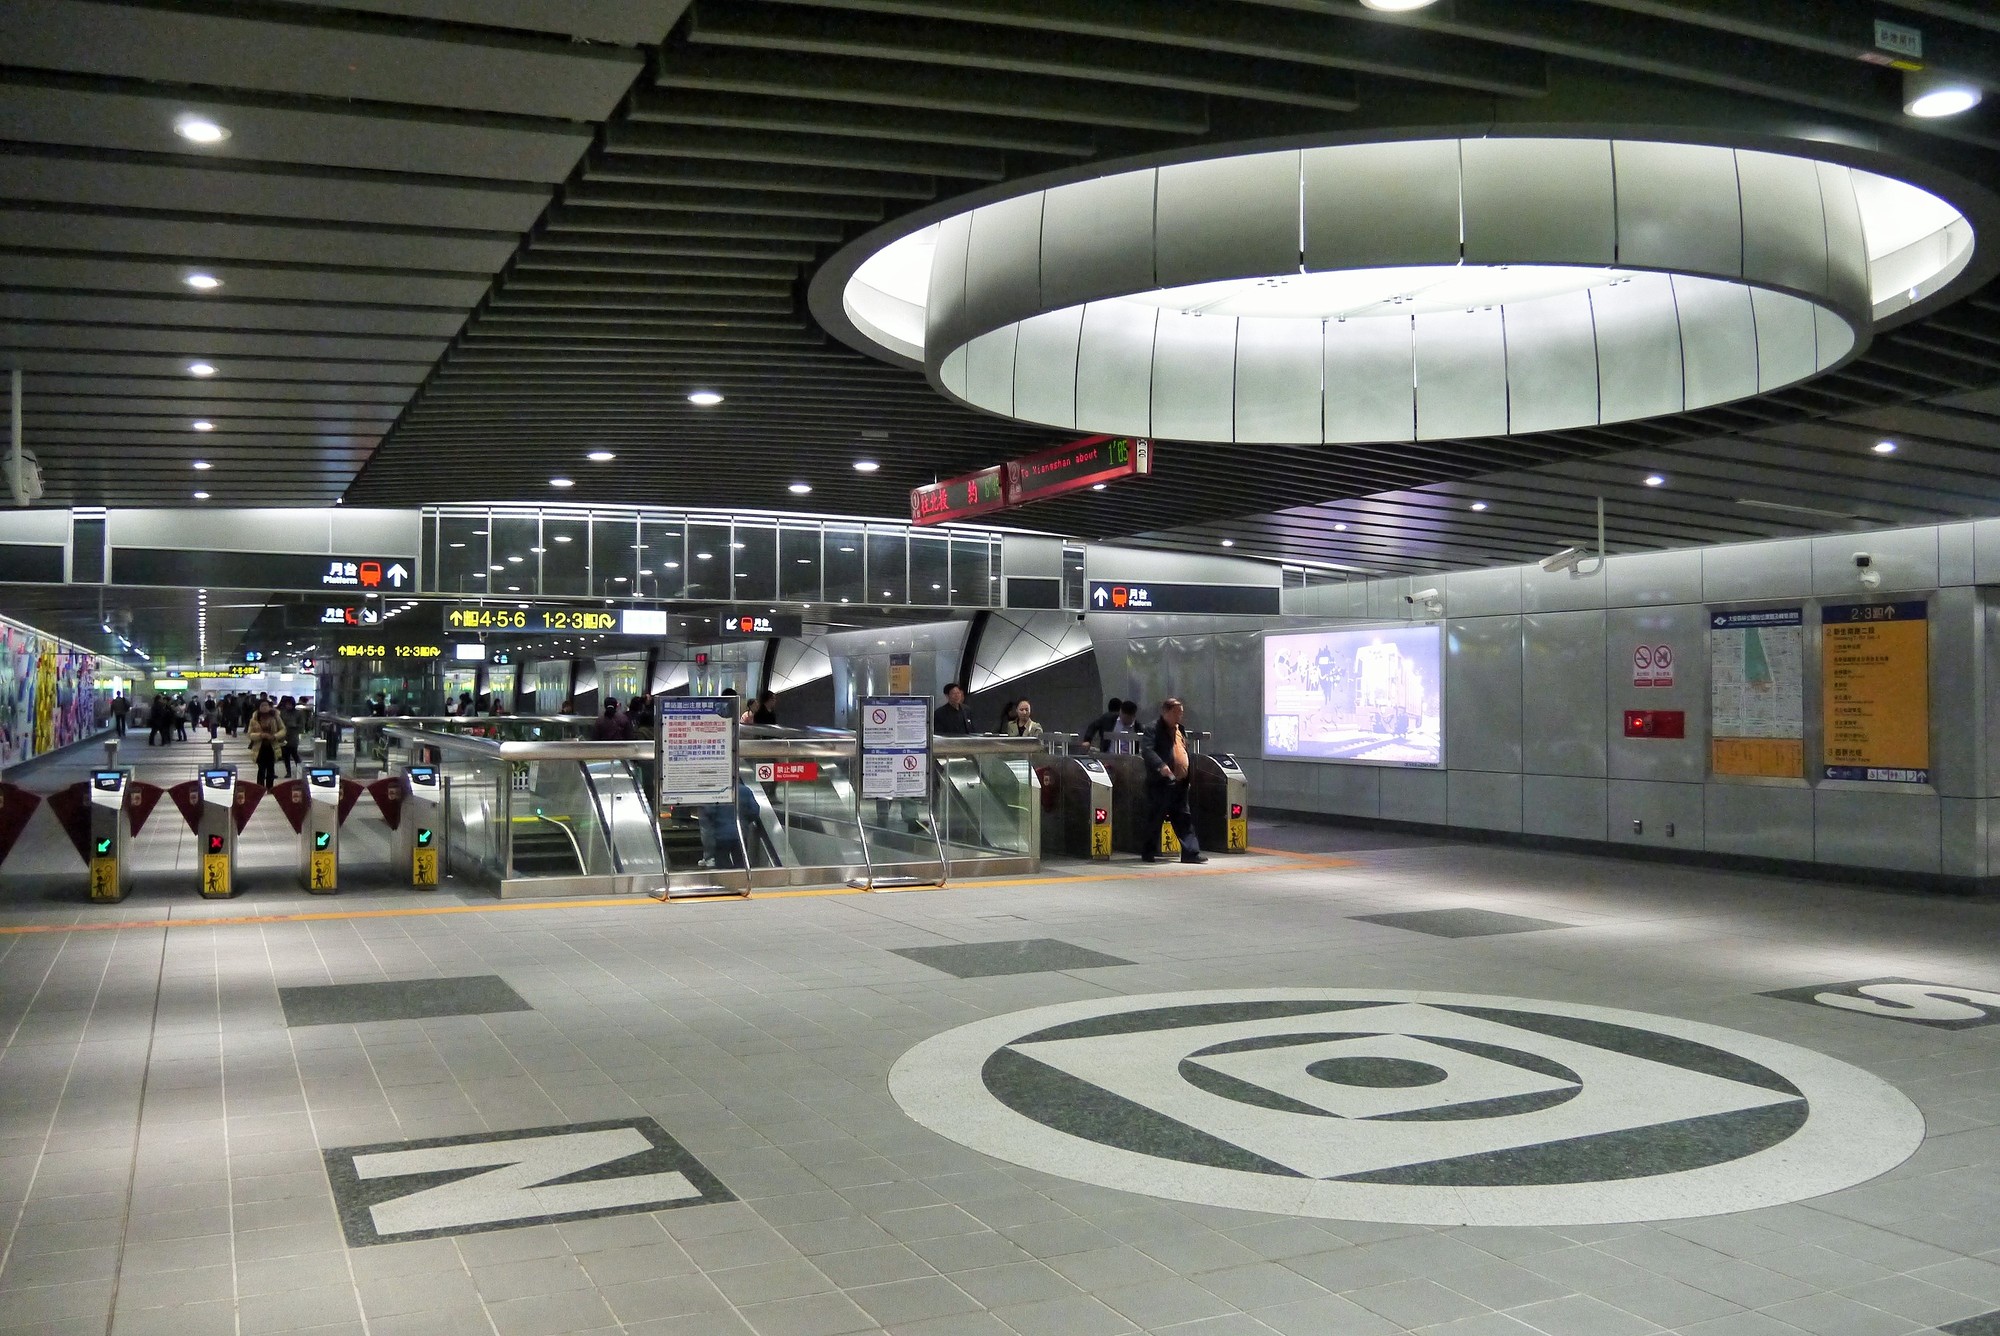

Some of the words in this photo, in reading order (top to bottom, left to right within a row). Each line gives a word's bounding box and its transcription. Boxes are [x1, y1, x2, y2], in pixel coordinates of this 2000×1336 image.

[1021, 468, 1030, 478] To
[1075, 448, 1098, 464] about
[921, 488, 949, 517] 往北投
[329, 562, 358, 576] 月台
[323, 575, 358, 585] Platform
[1129, 588, 1148, 600] 月台
[1129, 599, 1152, 607] Platform
